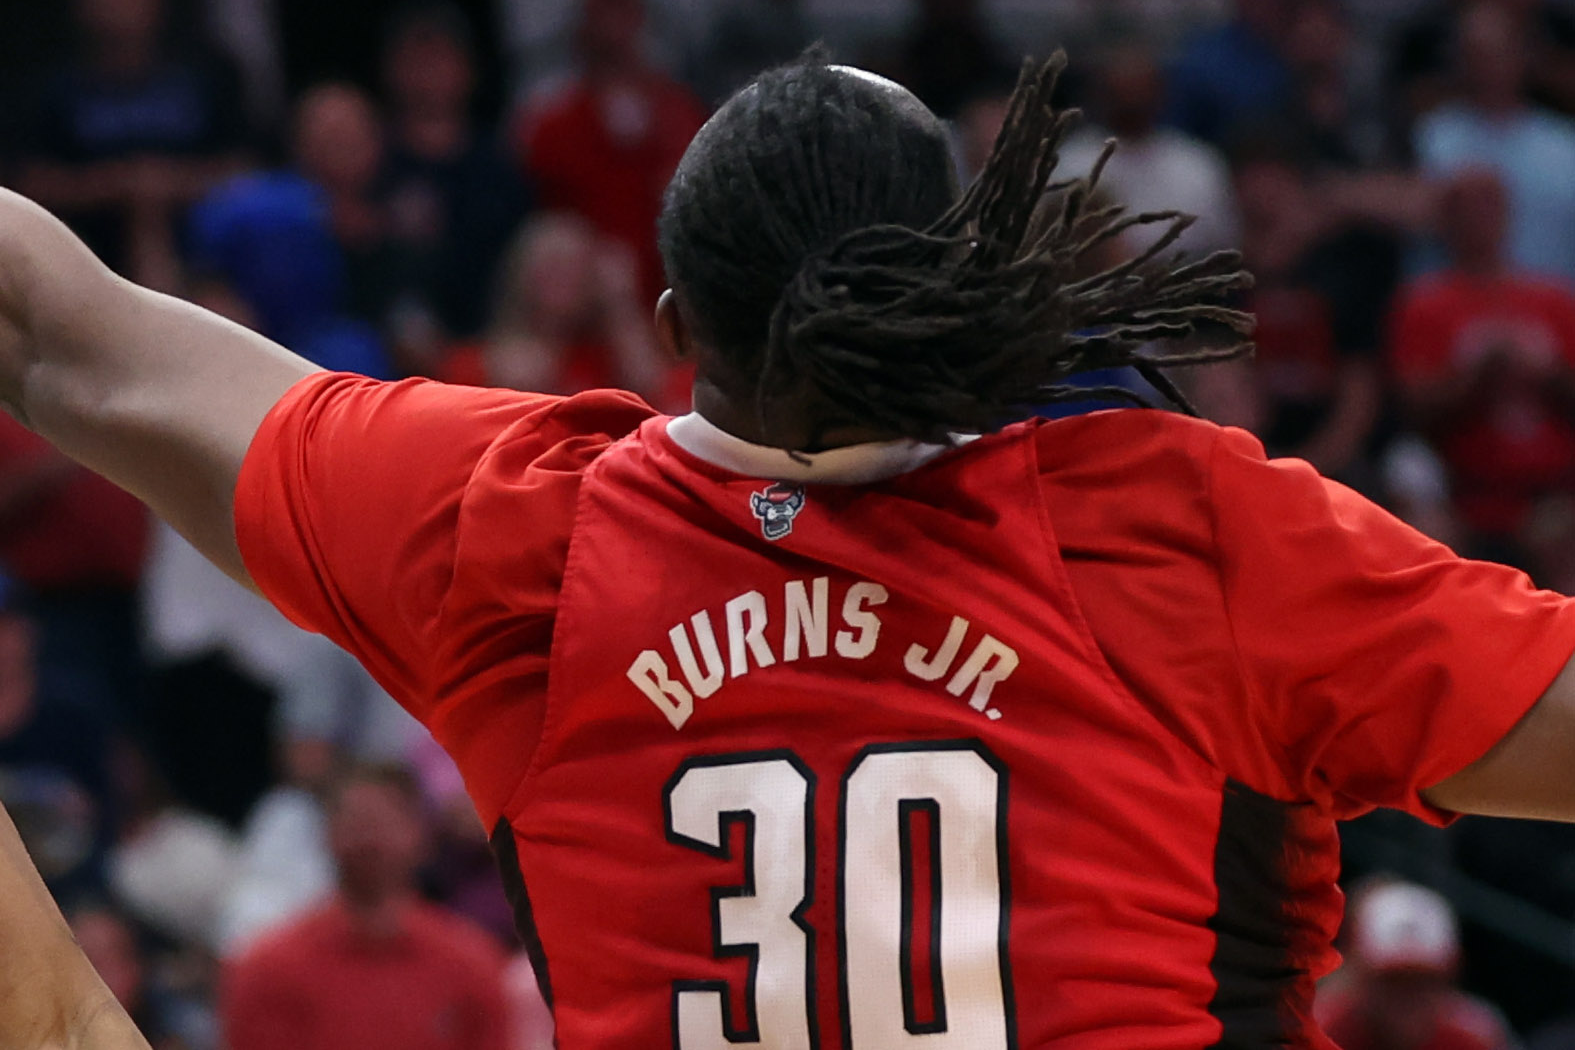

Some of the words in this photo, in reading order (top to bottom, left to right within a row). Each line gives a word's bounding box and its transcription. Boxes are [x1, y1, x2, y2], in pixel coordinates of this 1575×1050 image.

[626, 576, 889, 731] BURNS
[903, 616, 1020, 721] JR.
[662, 740, 1017, 1050] 30
